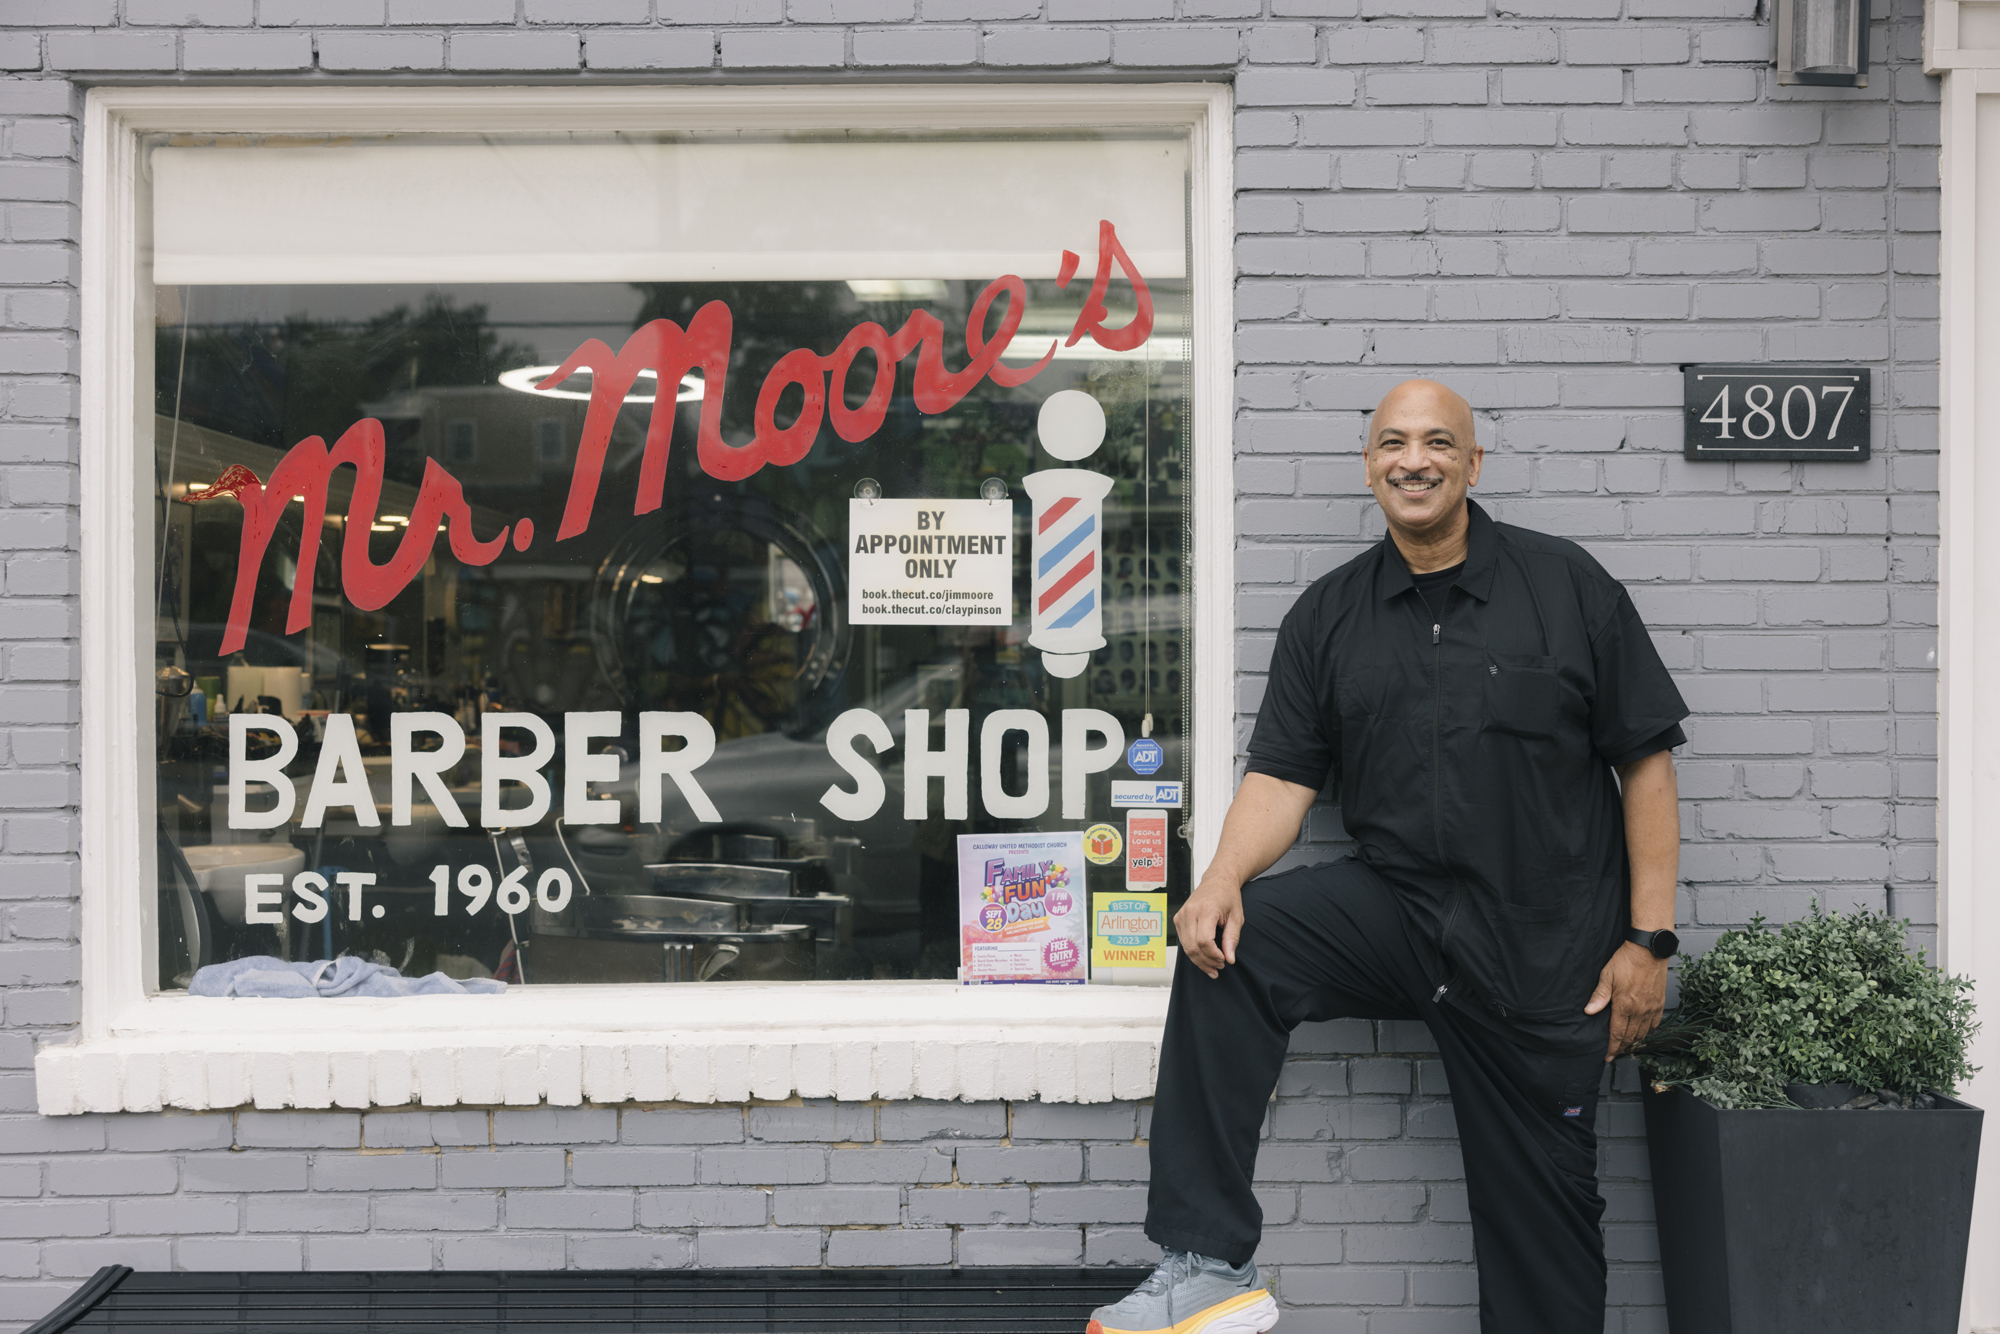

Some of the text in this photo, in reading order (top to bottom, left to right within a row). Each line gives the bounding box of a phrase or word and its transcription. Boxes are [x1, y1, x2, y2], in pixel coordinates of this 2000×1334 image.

[1700, 384, 1855, 440] 4807
[181, 219, 1154, 656] Mr. Moore's
[917, 511, 945, 530] BY
[855, 535, 1006, 554] APPOINTMENT
[905, 559, 957, 578] ONLY
[862, 589, 994, 602] book.thecut.co/jimmoore
[862, 604, 1002, 617] book.thecut.co/claypinson
[1134, 750, 1157, 763] ADT
[228, 708, 1125, 829] BARBER SHOP
[1144, 794, 1154, 802] by
[1156, 788, 1179, 801] ADT
[1132, 857, 1153, 868] yelp
[985, 858, 1053, 887] FAMILY
[245, 864, 572, 924] EST. 1960
[1003, 879, 1046, 904] FUN
[1112, 902, 1148, 910] BEST OF
[986, 910, 1002, 918] SEPT
[986, 918, 1002, 930] 28
[1101, 915, 1158, 933] Arlington
[1050, 940, 1068, 952] FREE
[1117, 936, 1140, 944] 2023
[1050, 949, 1074, 962] ENTRY
[1103, 950, 1156, 961] WINNER
